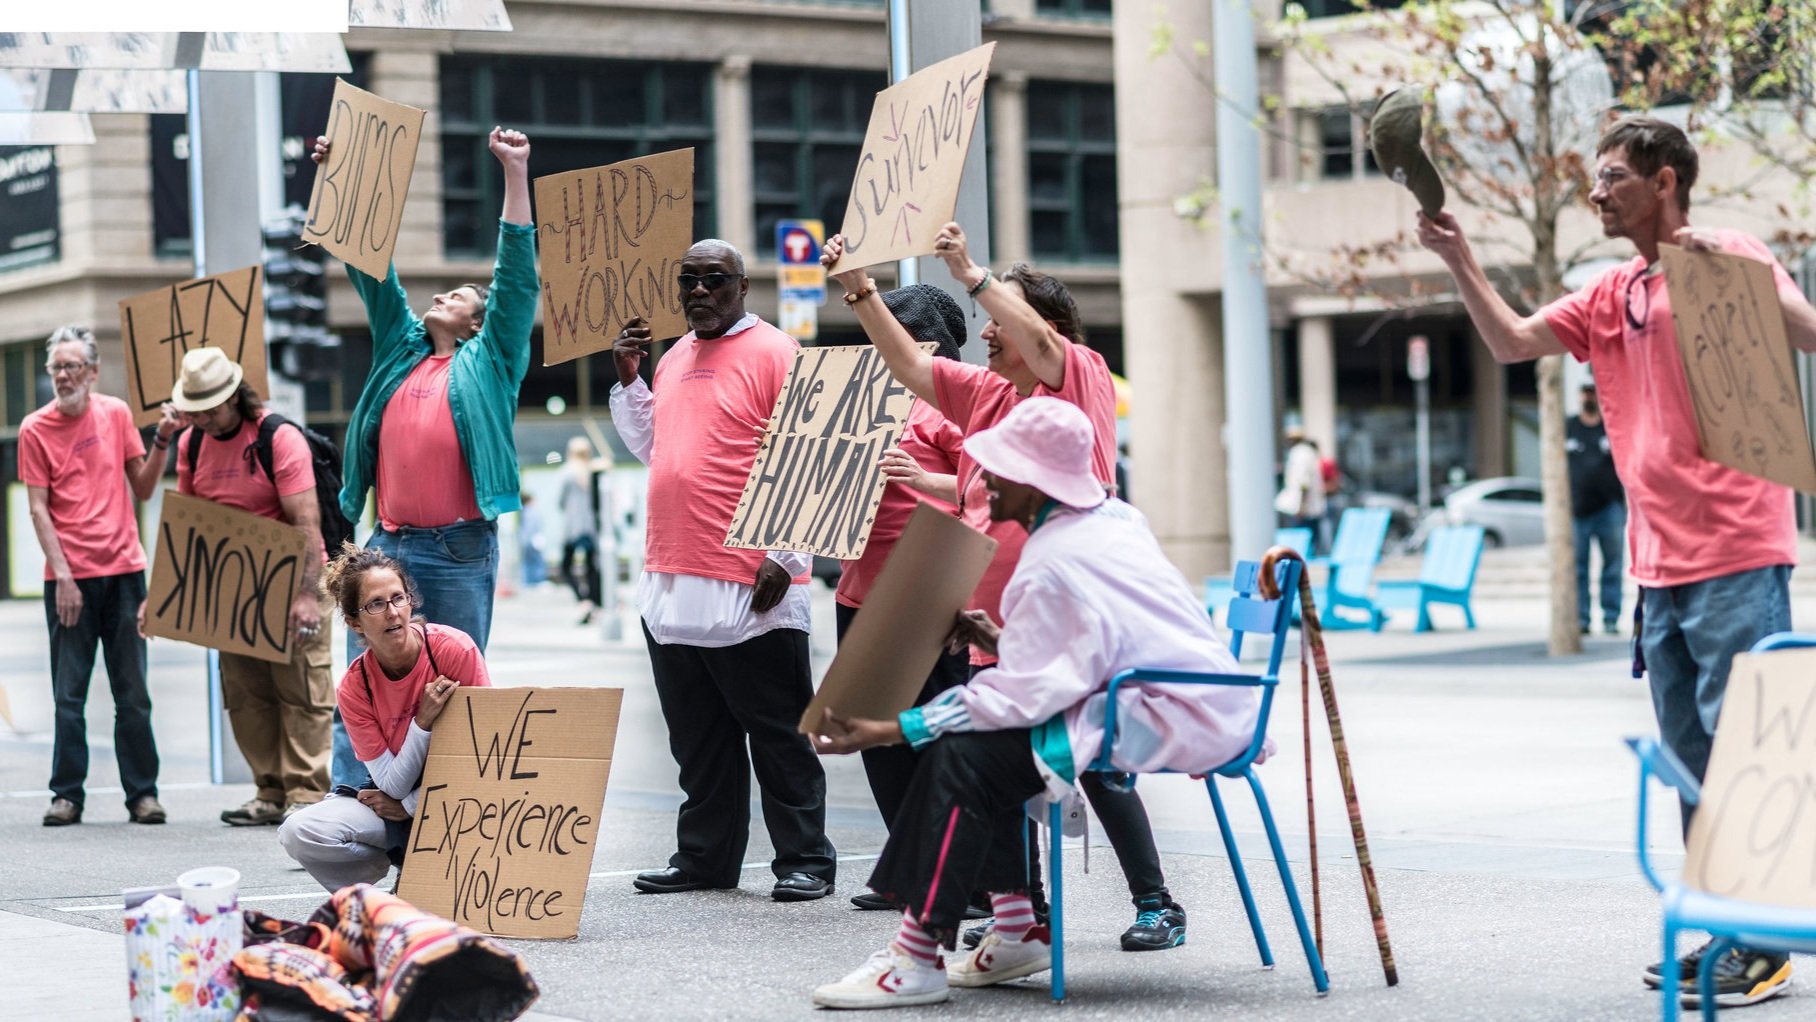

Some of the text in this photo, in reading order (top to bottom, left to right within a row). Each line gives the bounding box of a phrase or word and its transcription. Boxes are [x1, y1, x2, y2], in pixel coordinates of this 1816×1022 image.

[306, 99, 407, 256] BUMS
[562, 164, 658, 263] HARD
[820, 347, 906, 438] ARE
[733, 430, 893, 556] HUMAN
[156, 522, 298, 654] DRUNK
[466, 691, 557, 781] WE
[412, 783, 592, 880] Experience
[453, 846, 563, 932] Violence
